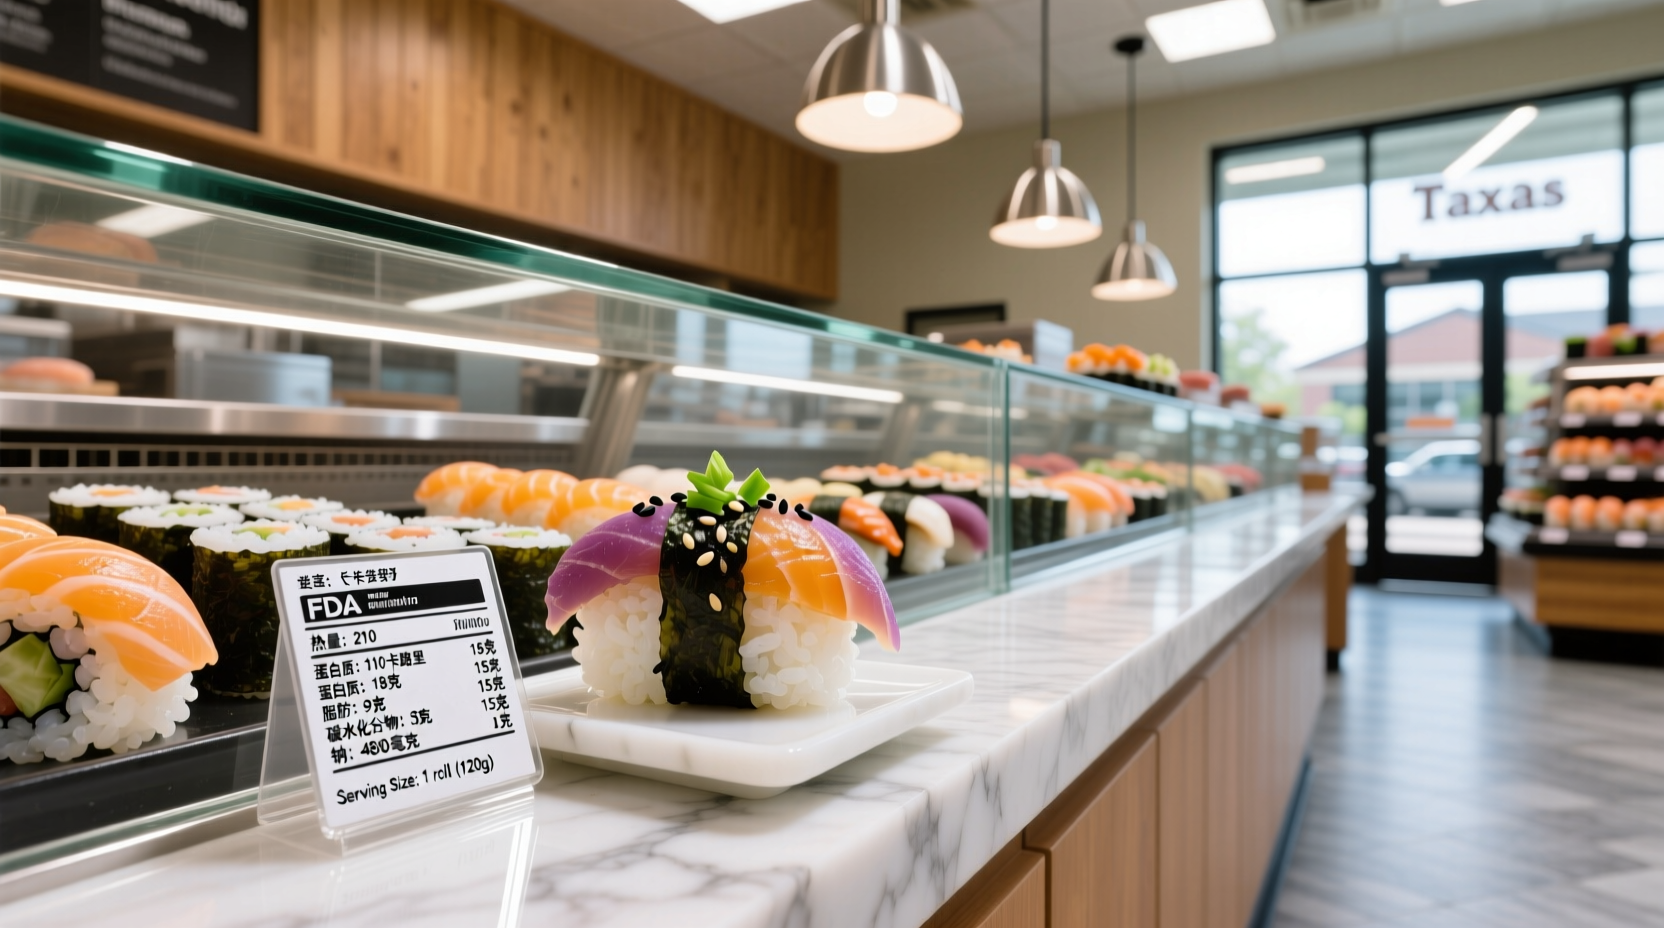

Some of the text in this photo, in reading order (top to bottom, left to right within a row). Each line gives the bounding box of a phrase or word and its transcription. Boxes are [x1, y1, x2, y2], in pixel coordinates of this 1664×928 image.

[1413, 178, 1566, 221] Taxas
[307, 593, 363, 620] FDA
[353, 629, 377, 645] 210
[478, 676, 506, 693] 15克
[363, 695, 386, 713] 9克
[481, 693, 509, 711] 15克
[336, 754, 494, 805] Serving Size: 1 roll (120g)
